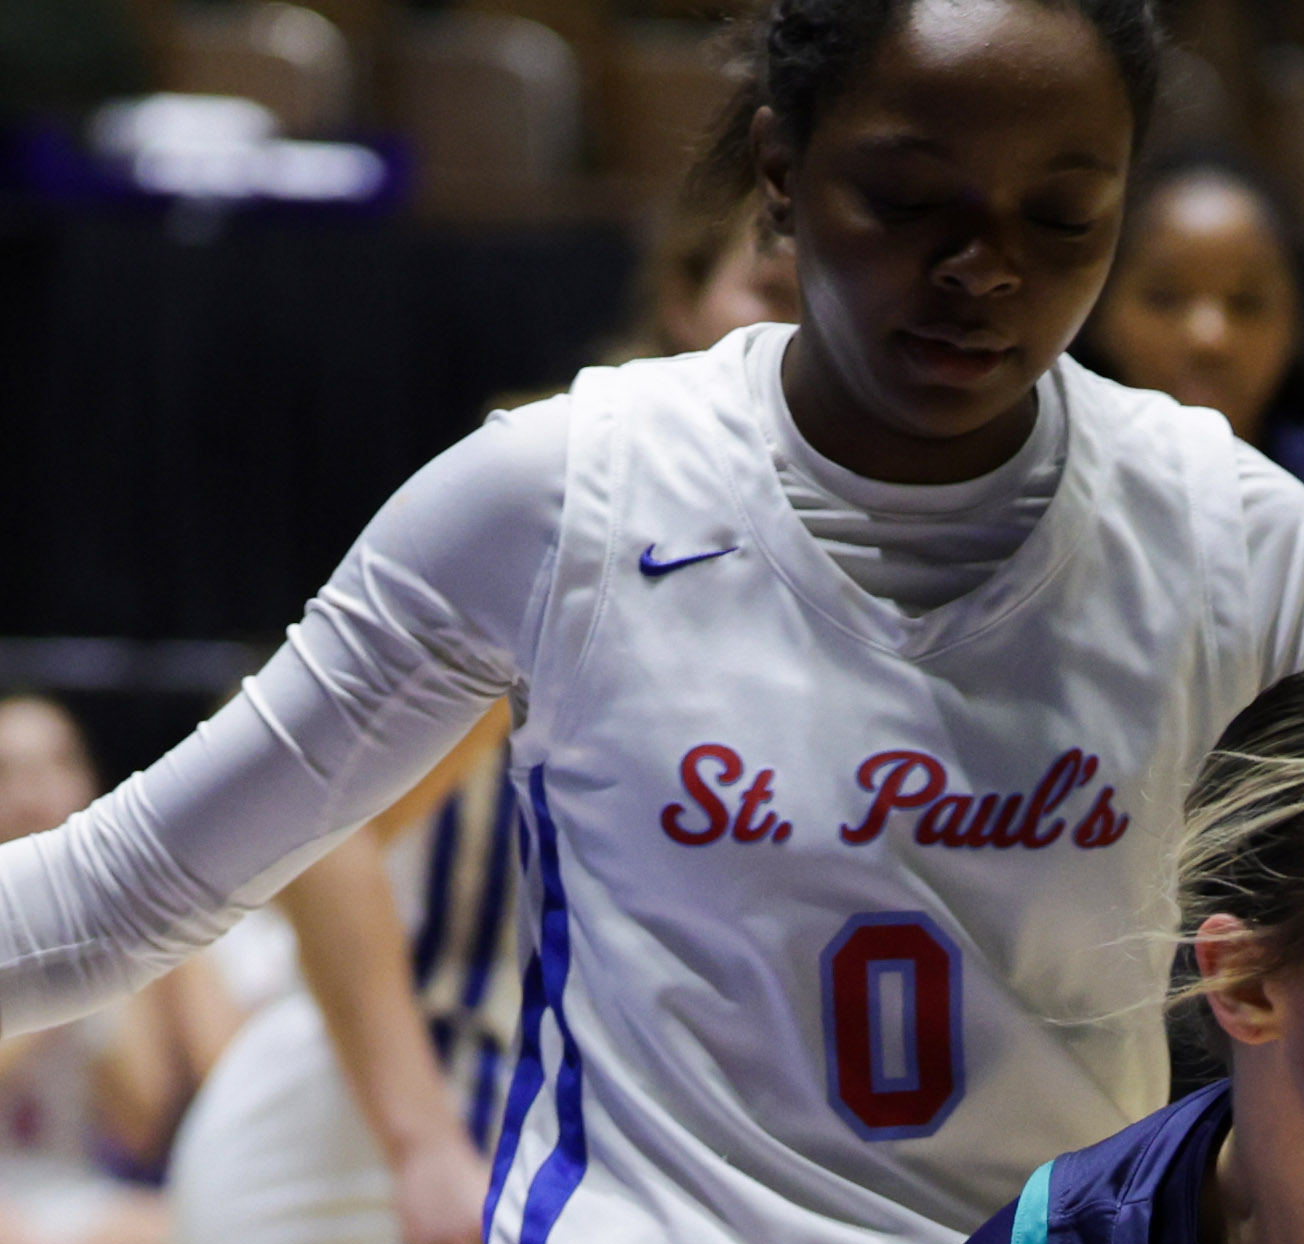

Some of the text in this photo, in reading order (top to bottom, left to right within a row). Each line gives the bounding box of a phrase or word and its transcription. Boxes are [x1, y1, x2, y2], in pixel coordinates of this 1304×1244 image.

[660, 743, 1131, 850] St. Paul's
[820, 910, 967, 1142] 0
